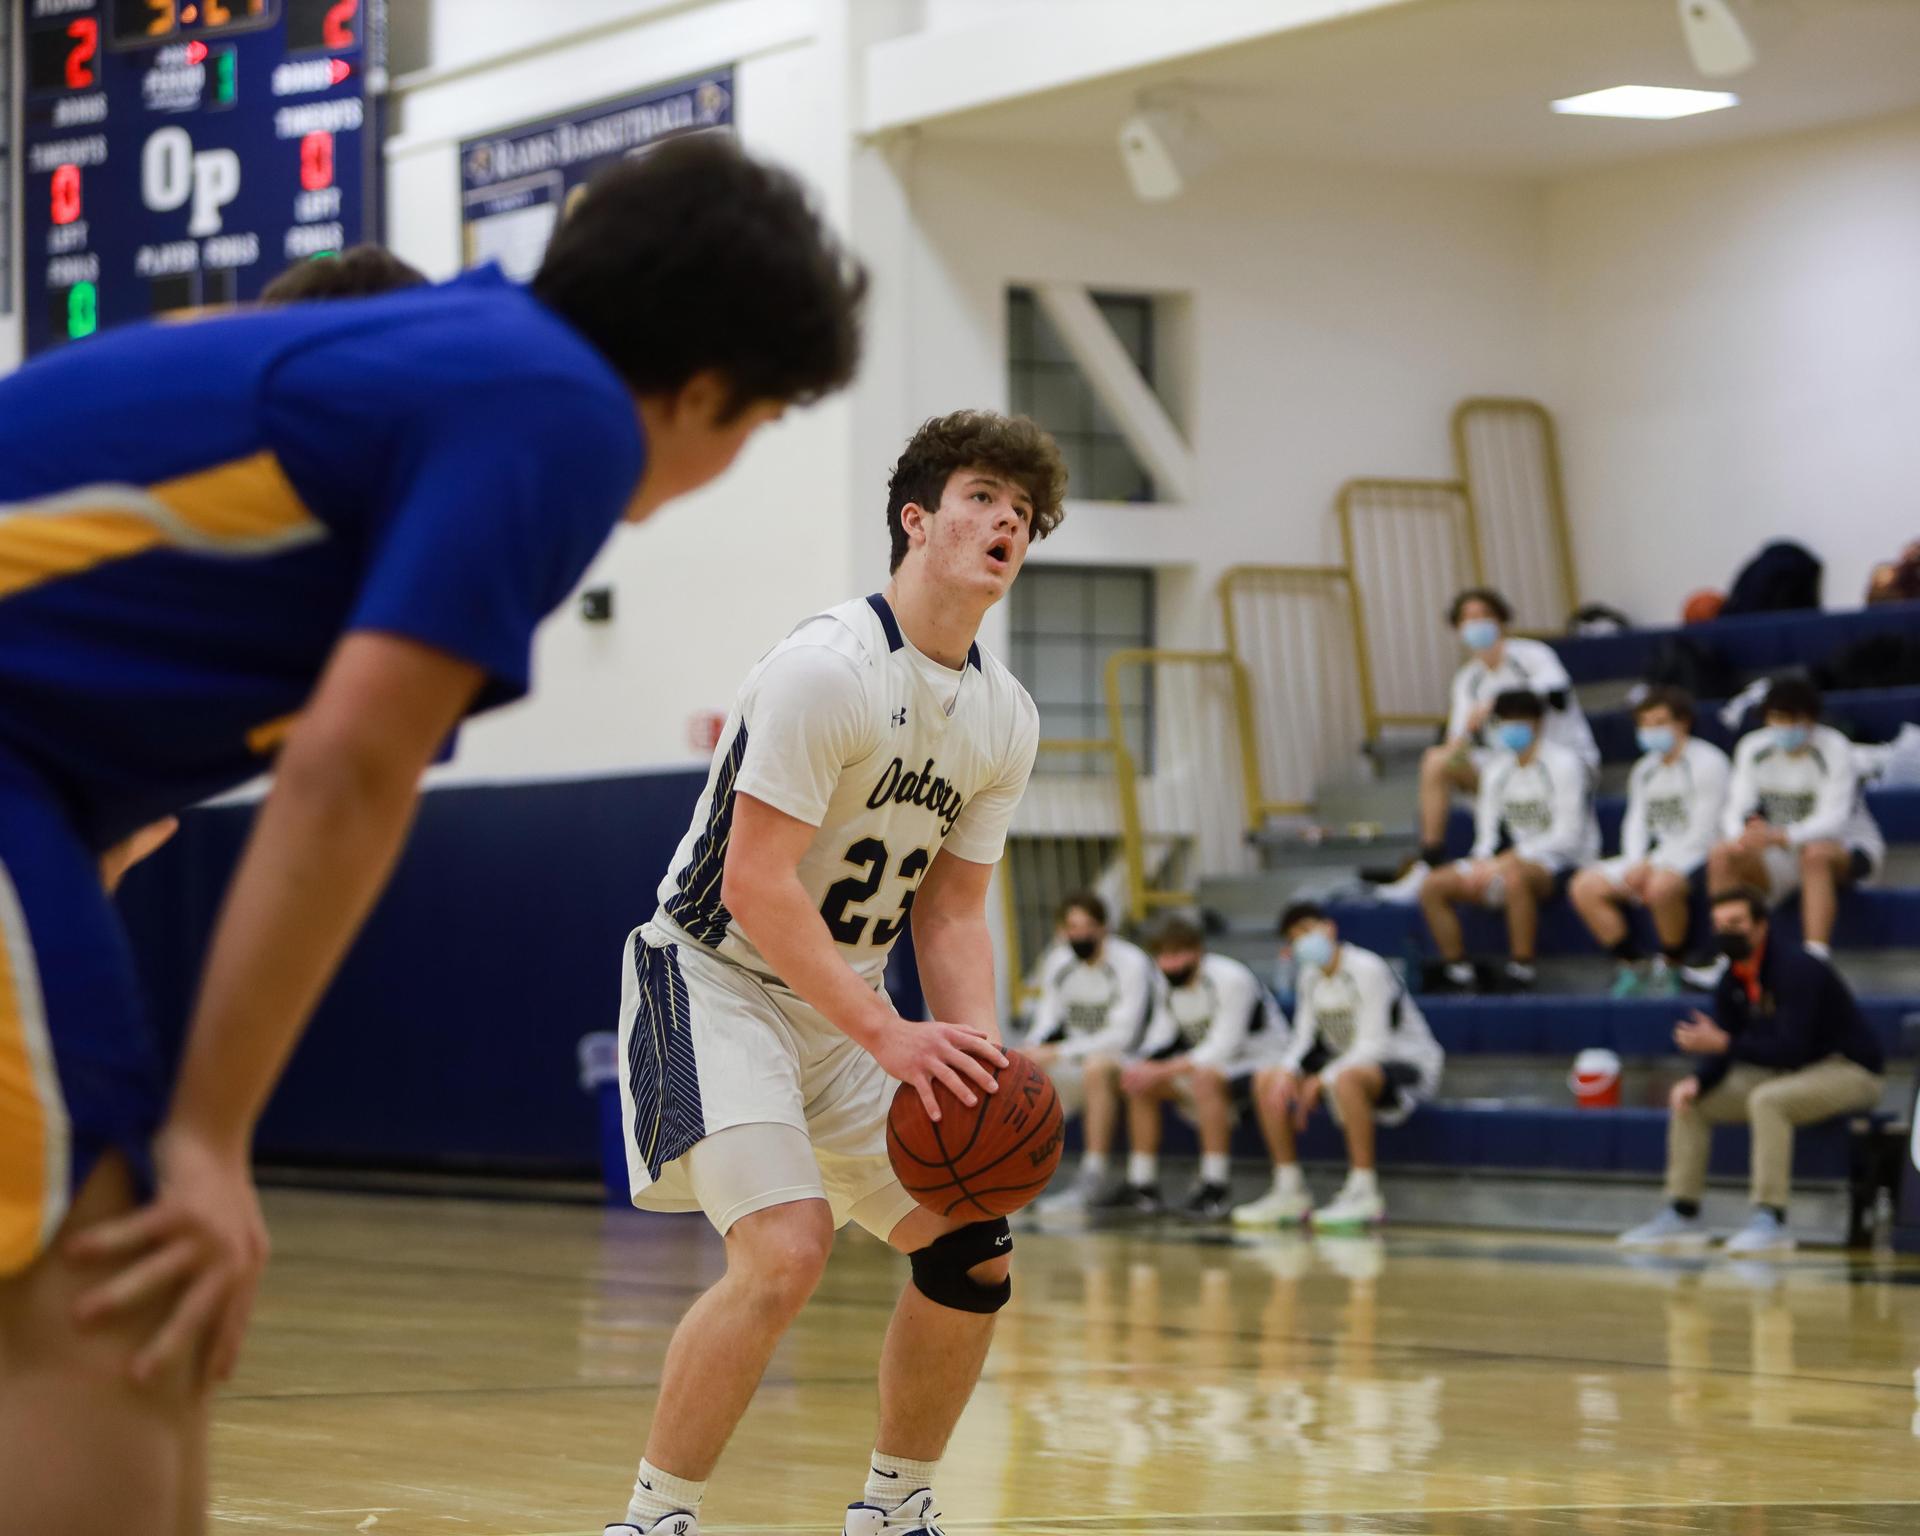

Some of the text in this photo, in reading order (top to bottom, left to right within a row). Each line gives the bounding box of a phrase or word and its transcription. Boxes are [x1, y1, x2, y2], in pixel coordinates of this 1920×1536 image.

[66, 17, 98, 89] 2
[300, 131, 333, 191] 0
[51, 164, 81, 225] 0
[819, 836, 930, 946] 23
